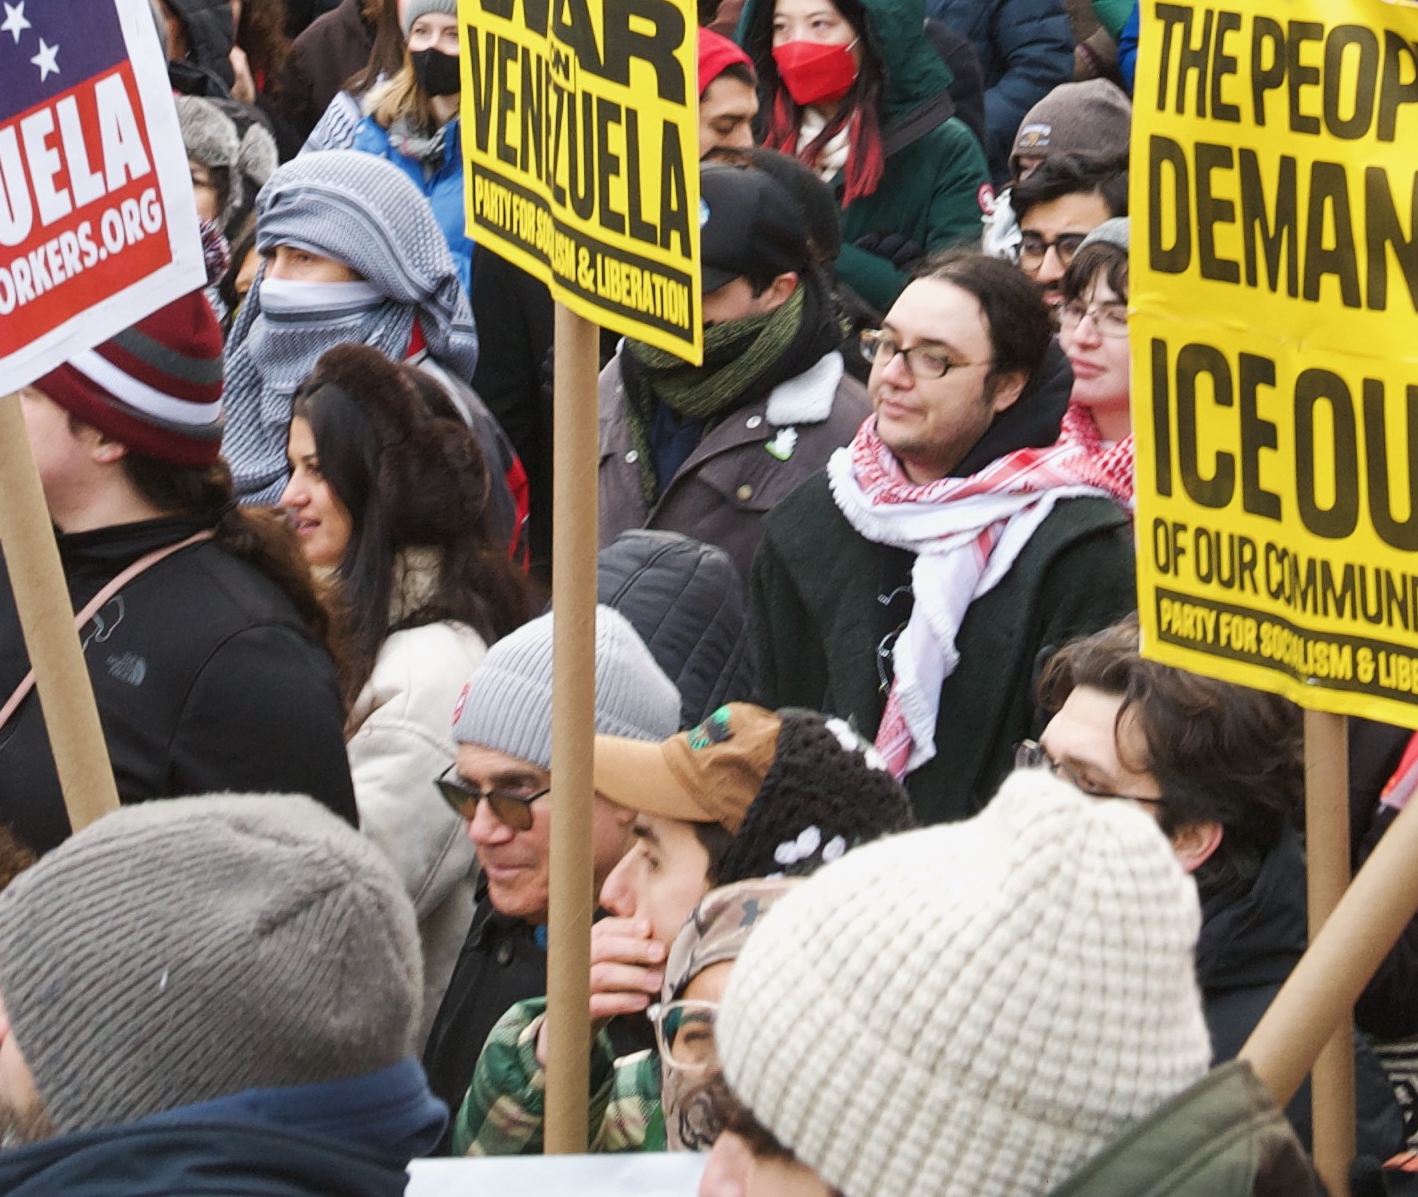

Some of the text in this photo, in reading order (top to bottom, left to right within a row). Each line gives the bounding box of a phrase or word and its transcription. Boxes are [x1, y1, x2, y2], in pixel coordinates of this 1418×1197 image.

[1155, 2, 1242, 123] THE
[467, 23, 693, 260] VENEZUELA
[474, 174, 512, 231] PARTY
[512, 194, 537, 244] FOR
[577, 246, 596, 291] &
[596, 252, 690, 329] LIBERATION
[1151, 337, 1282, 523] ICE
[1153, 517, 1188, 578] OF
[1194, 526, 1258, 595] OUR
[1159, 597, 1217, 643] PARTY
[1219, 610, 1258, 651] FOR
[1258, 619, 1353, 682] SOCIALISM
[1356, 649, 1376, 684] &
